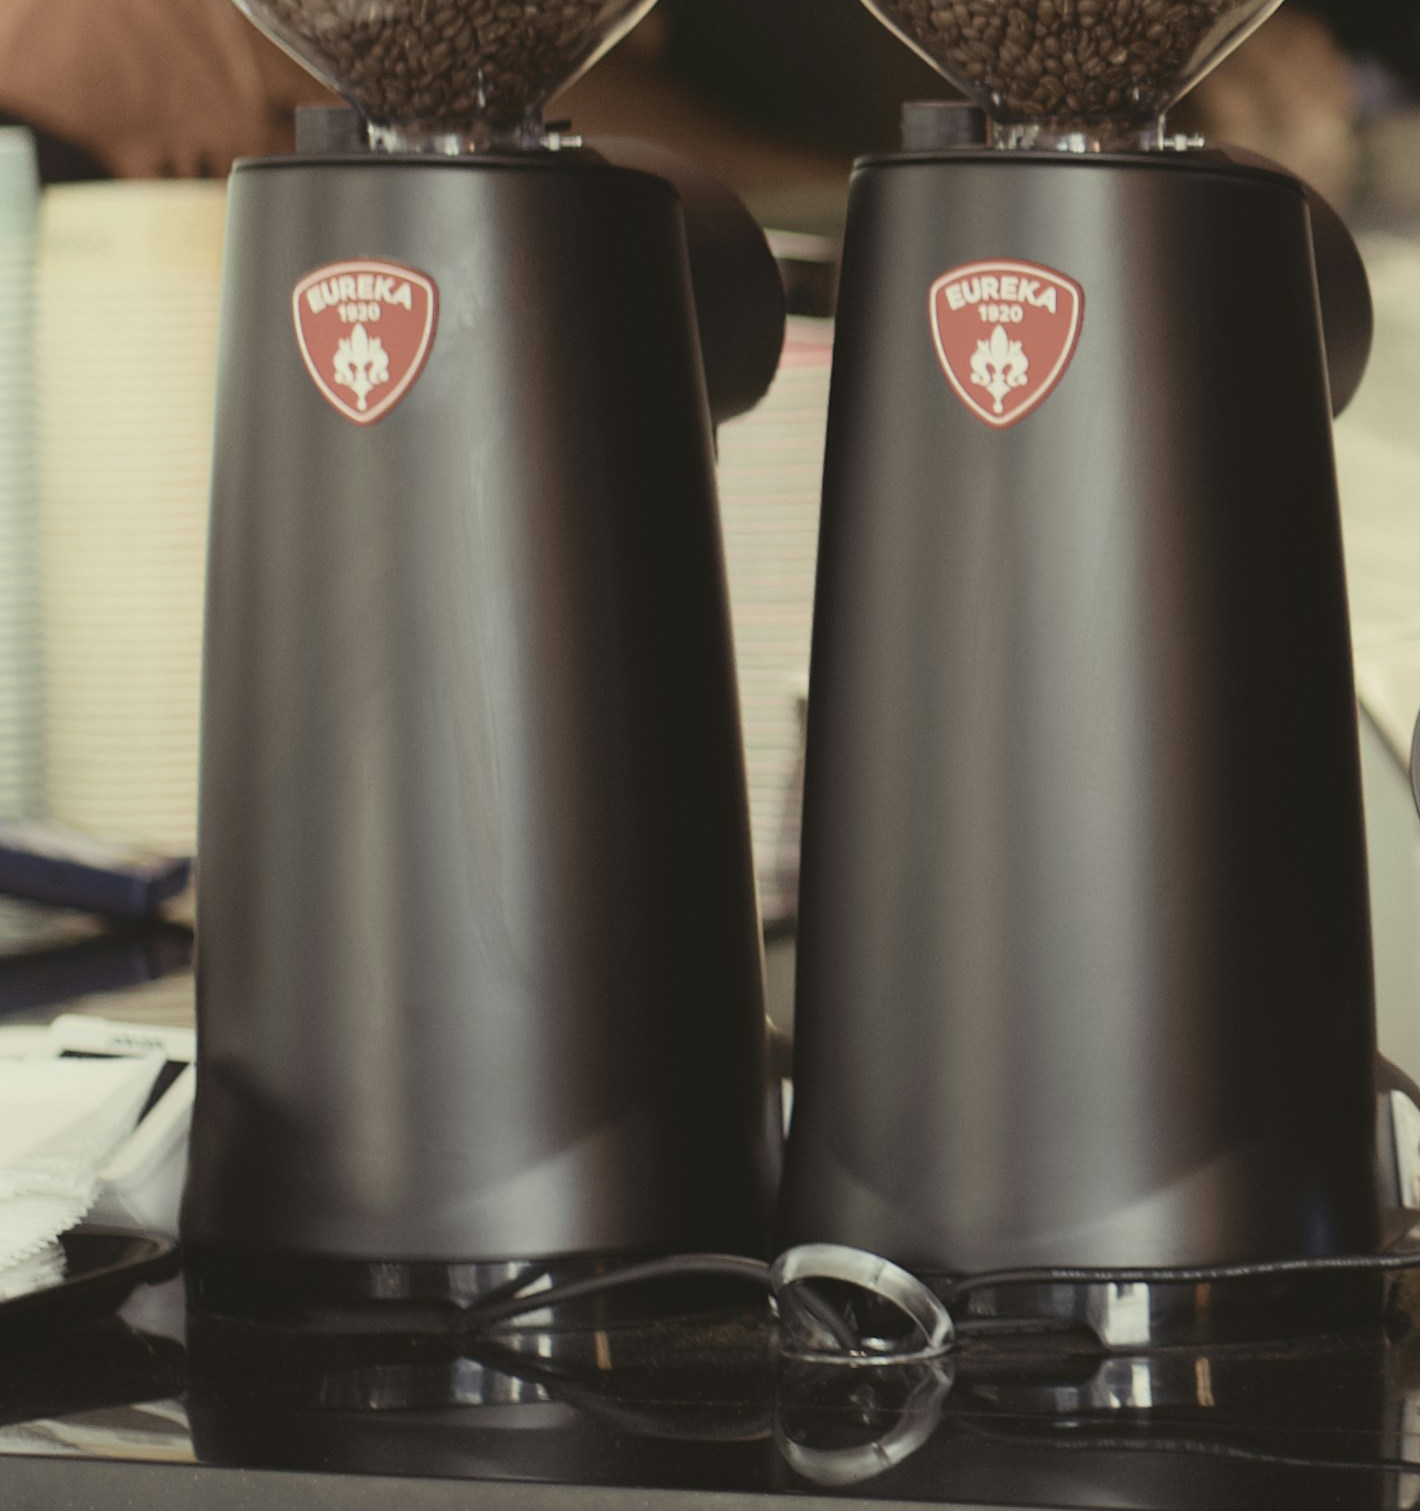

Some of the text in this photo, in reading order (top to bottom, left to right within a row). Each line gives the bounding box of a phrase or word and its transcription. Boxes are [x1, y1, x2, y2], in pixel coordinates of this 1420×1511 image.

[306, 273, 412, 315] EUREKA
[945, 274, 1057, 315] EUREKA
[978, 303, 1024, 323] 1920
